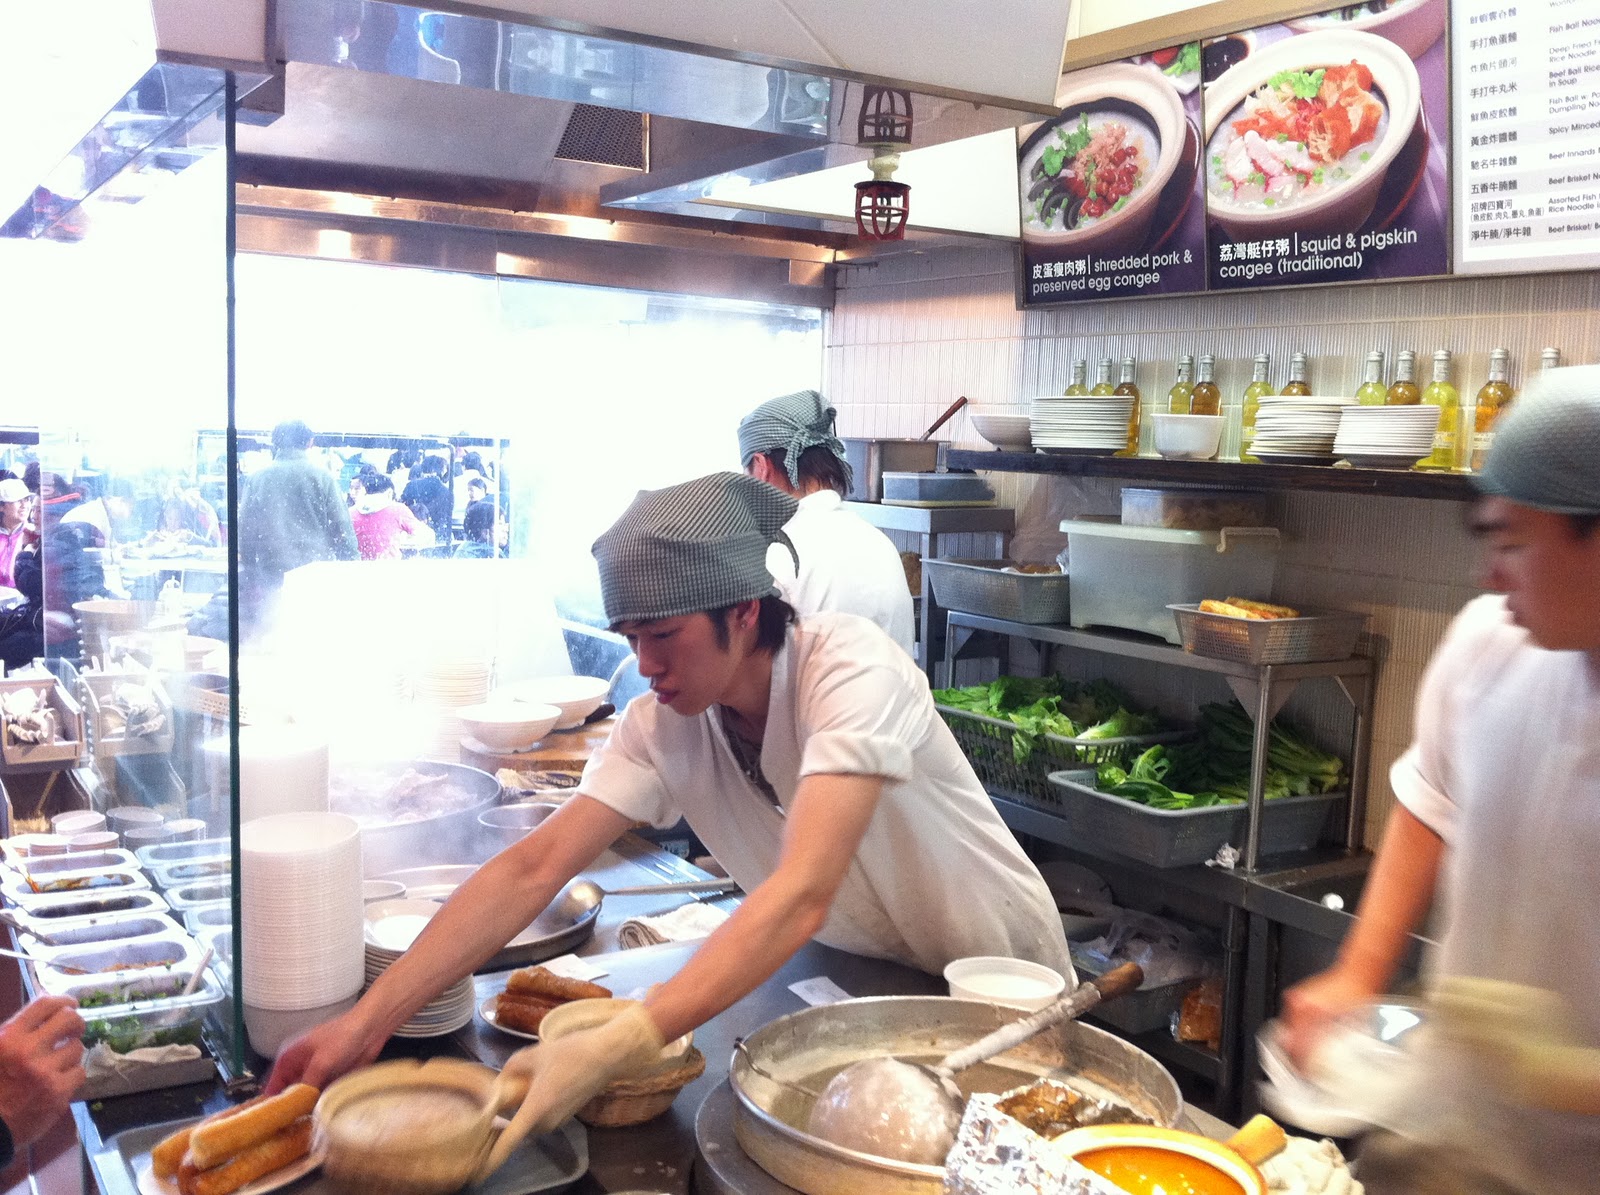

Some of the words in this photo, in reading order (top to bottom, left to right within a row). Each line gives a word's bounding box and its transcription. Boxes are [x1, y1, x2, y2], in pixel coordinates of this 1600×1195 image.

[1549, 25, 1563, 33] Fish
[1566, 21, 1579, 31] Ball
[1568, 50, 1596, 60] Noodle
[1549, 69, 1565, 79] Beef
[1567, 66, 1581, 75] Ball
[1584, 64, 1600, 73] Rice
[1558, 77, 1577, 86] Soup
[1565, 95, 1579, 103] Ball
[1549, 103, 1586, 114] Dumpling
[1549, 126, 1570, 135] Spicy
[1549, 151, 1565, 160] Beef
[1549, 176, 1565, 185] Beef
[1567, 173, 1591, 183] Brisket
[1548, 195, 1580, 204] Assorted
[1583, 193, 1596, 201] Fish
[1567, 202, 1594, 211] Noodle
[1548, 225, 1565, 234] Beef
[1301, 234, 1341, 255] squid
[1345, 232, 1357, 249] &
[1360, 227, 1417, 250] pigskin
[1219, 238, 1290, 262] 荔灣艇仔粥
[1094, 253, 1149, 273] shredded
[1152, 251, 1180, 269] pork
[1183, 249, 1193, 264] &
[1219, 261, 1273, 279] congee
[1277, 252, 1363, 275] (traditional)
[1032, 259, 1087, 280] 皮蛋瘦肉粥
[1032, 277, 1086, 296] preserved
[1088, 276, 1111, 291] egg
[1113, 272, 1160, 288] congee
